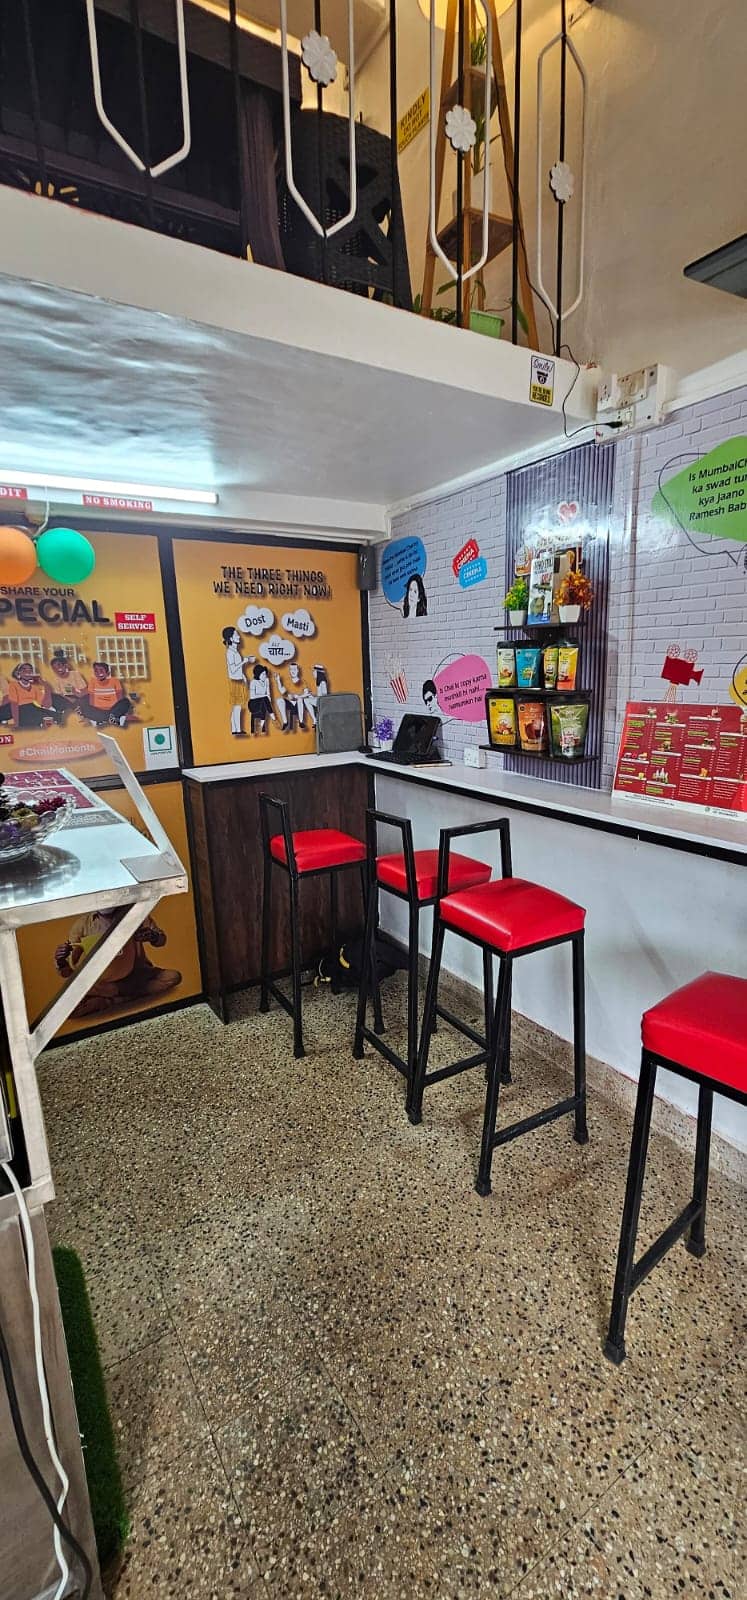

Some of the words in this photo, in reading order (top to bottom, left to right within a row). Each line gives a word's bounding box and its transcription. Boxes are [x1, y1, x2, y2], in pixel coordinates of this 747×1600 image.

[400, 92, 426, 129] KINDLY
[692, 485, 703, 494] ka
[705, 476, 731, 491] swad
[86, 496, 100, 505] NO
[104, 499, 151, 510] SMOKING
[698, 496, 715, 507] kya
[689, 507, 725, 520] Ramesh
[221, 566, 242, 579] THE
[247, 568, 281, 581] THREE
[285, 570, 324, 582] THINGS
[0, 586, 40, 596] SHARE
[43, 588, 75, 597] YOUR
[213, 581, 230, 593] WE
[235, 582, 263, 594] NEED
[268, 584, 300, 596] RIGHT
[303, 585, 331, 597] NOW!
[245, 614, 266, 627] Dost
[287, 617, 309, 631] Masti
[20, 744, 96, 757] #ChaiMoments
